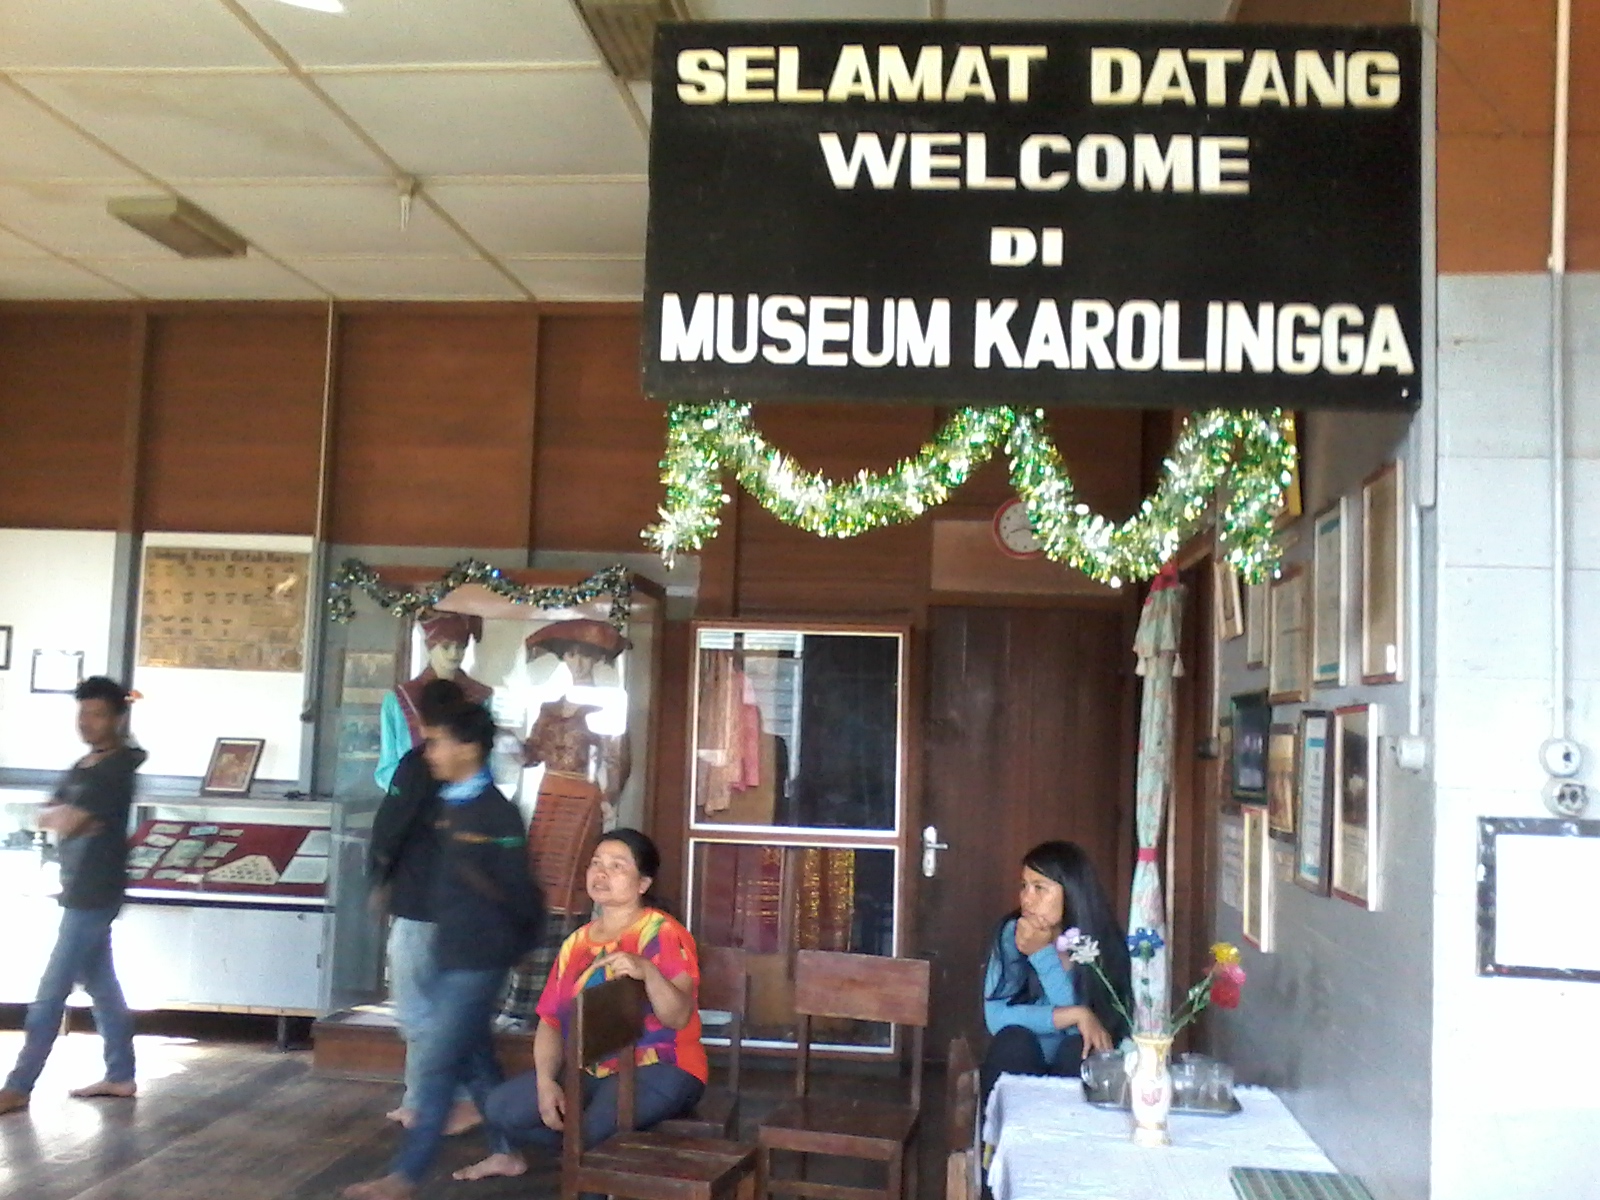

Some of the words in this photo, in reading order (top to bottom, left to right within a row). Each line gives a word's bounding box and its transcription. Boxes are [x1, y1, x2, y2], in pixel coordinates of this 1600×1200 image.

[677, 45, 1048, 104] SELAMAT
[1091, 48, 1401, 108] DATANG
[819, 133, 1250, 194] WELCOME
[990, 228, 1064, 267] DI
[660, 293, 951, 368] MUSEUM
[974, 299, 1414, 375] KAROLINGGA
